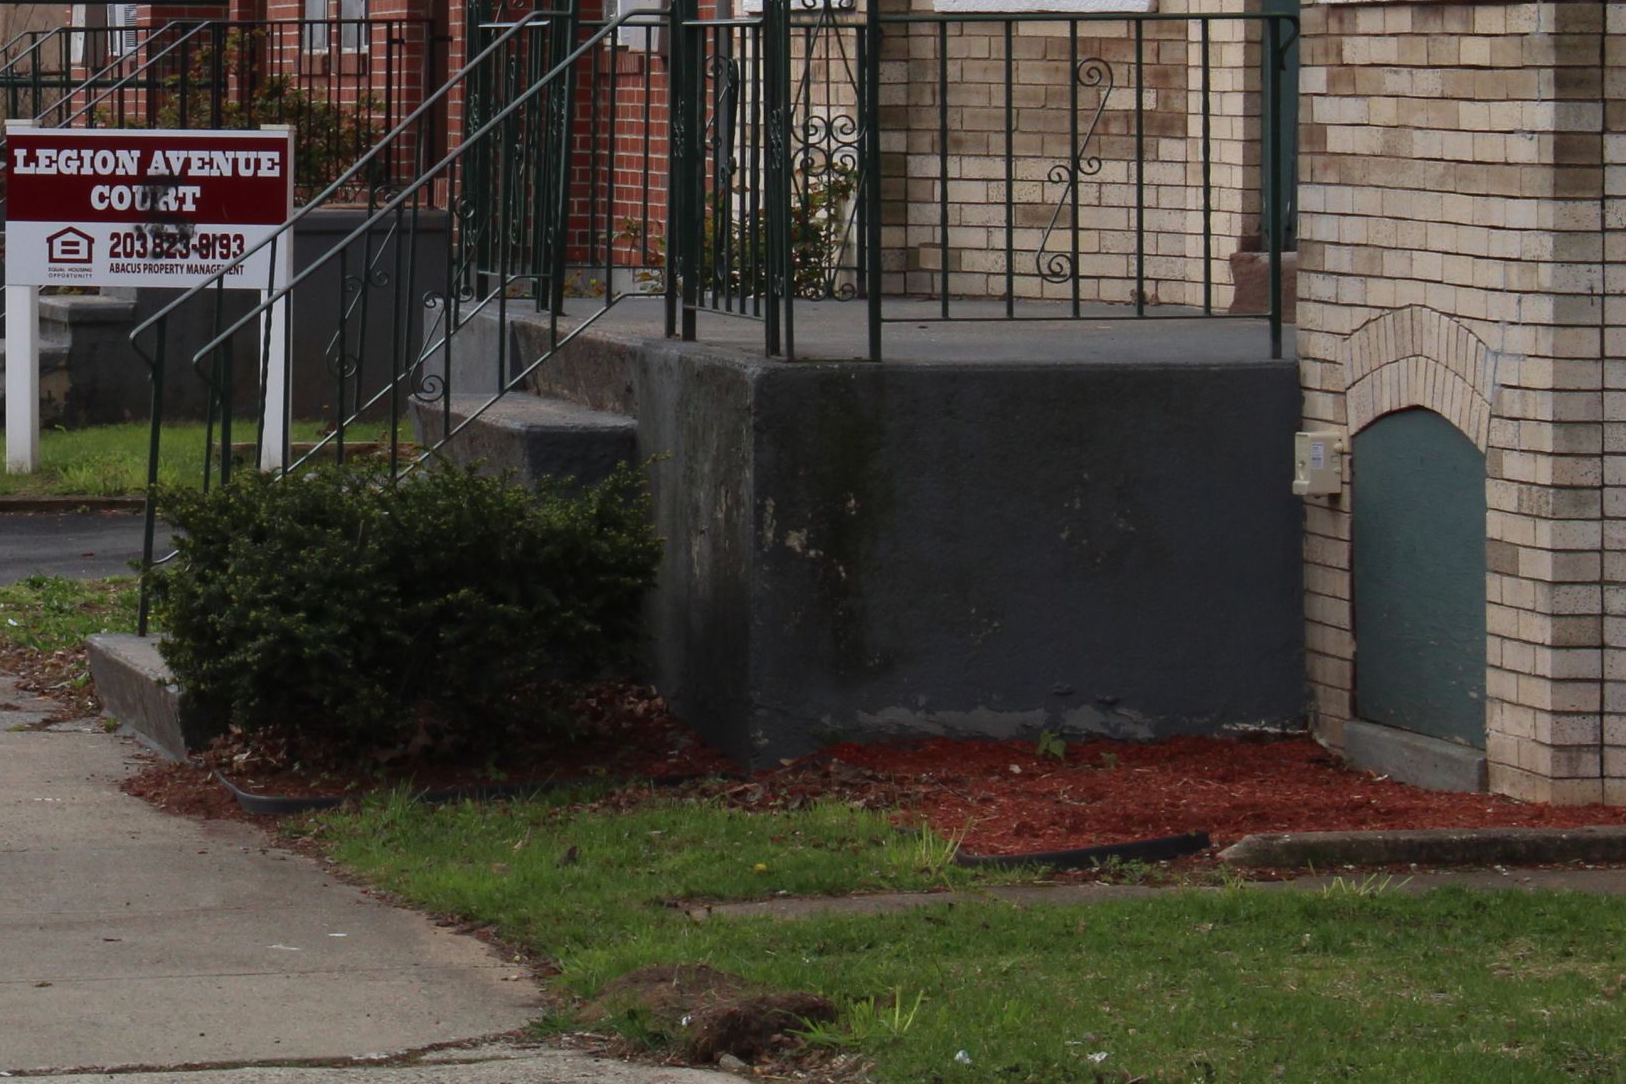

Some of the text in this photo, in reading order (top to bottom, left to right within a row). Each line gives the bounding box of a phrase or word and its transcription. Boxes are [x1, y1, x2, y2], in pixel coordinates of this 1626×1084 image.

[13, 148, 281, 178] LEGION AVENUE
[90, 184, 202, 212] COURT
[109, 231, 148, 259] 203
[109, 262, 142, 274] ABACUS
[143, 263, 185, 275] PROPERTY
